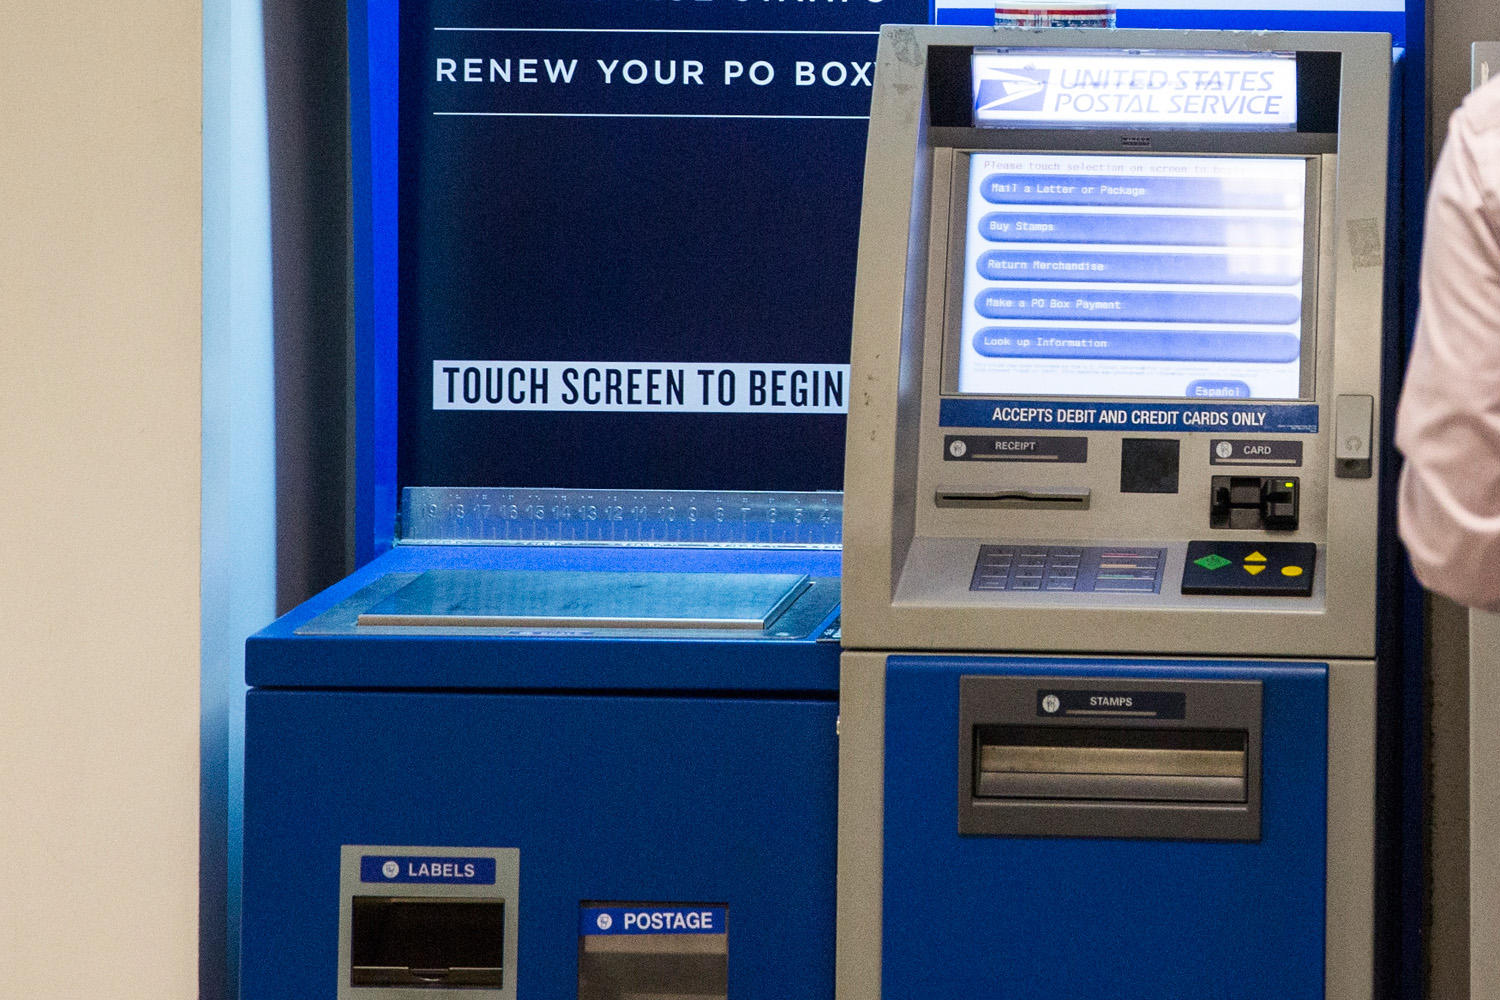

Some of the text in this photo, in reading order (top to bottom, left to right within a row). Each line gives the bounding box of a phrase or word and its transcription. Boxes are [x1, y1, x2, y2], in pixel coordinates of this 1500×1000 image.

[437, 58, 876, 87] RENEW YOUR PO BOX
[1060, 70, 1274, 92] UNITED STATES
[1054, 93, 1283, 115] POSTAL SERVICE
[984, 161, 1024, 172] Please
[1029, 162, 1061, 172] touch
[1066, 162, 1125, 174] selection
[1130, 165, 1144, 174] on
[1150, 164, 1188, 174] screen
[1194, 164, 1207, 175] to
[991, 183, 1146, 197] Mail a Letter or Package
[989, 221, 1054, 234] Buy Stamps
[987, 259, 1105, 272] Return Merchandise
[985, 298, 1122, 312] Make a PO Box Payment
[984, 337, 1108, 350] Look up Information
[443, 367, 842, 407] TOUCH SCREEN TO BEGIN
[1194, 385, 1241, 398] Español
[992, 407, 1266, 425] ACCEPTS DEBIT AND CREDIT CARDS ONLY
[994, 440, 1036, 452] RECEIPT
[1243, 445, 1272, 456] CARD
[1090, 696, 1133, 707] STAMPS
[409, 863, 475, 877] LABELS
[624, 912, 712, 929] POSTAGE
